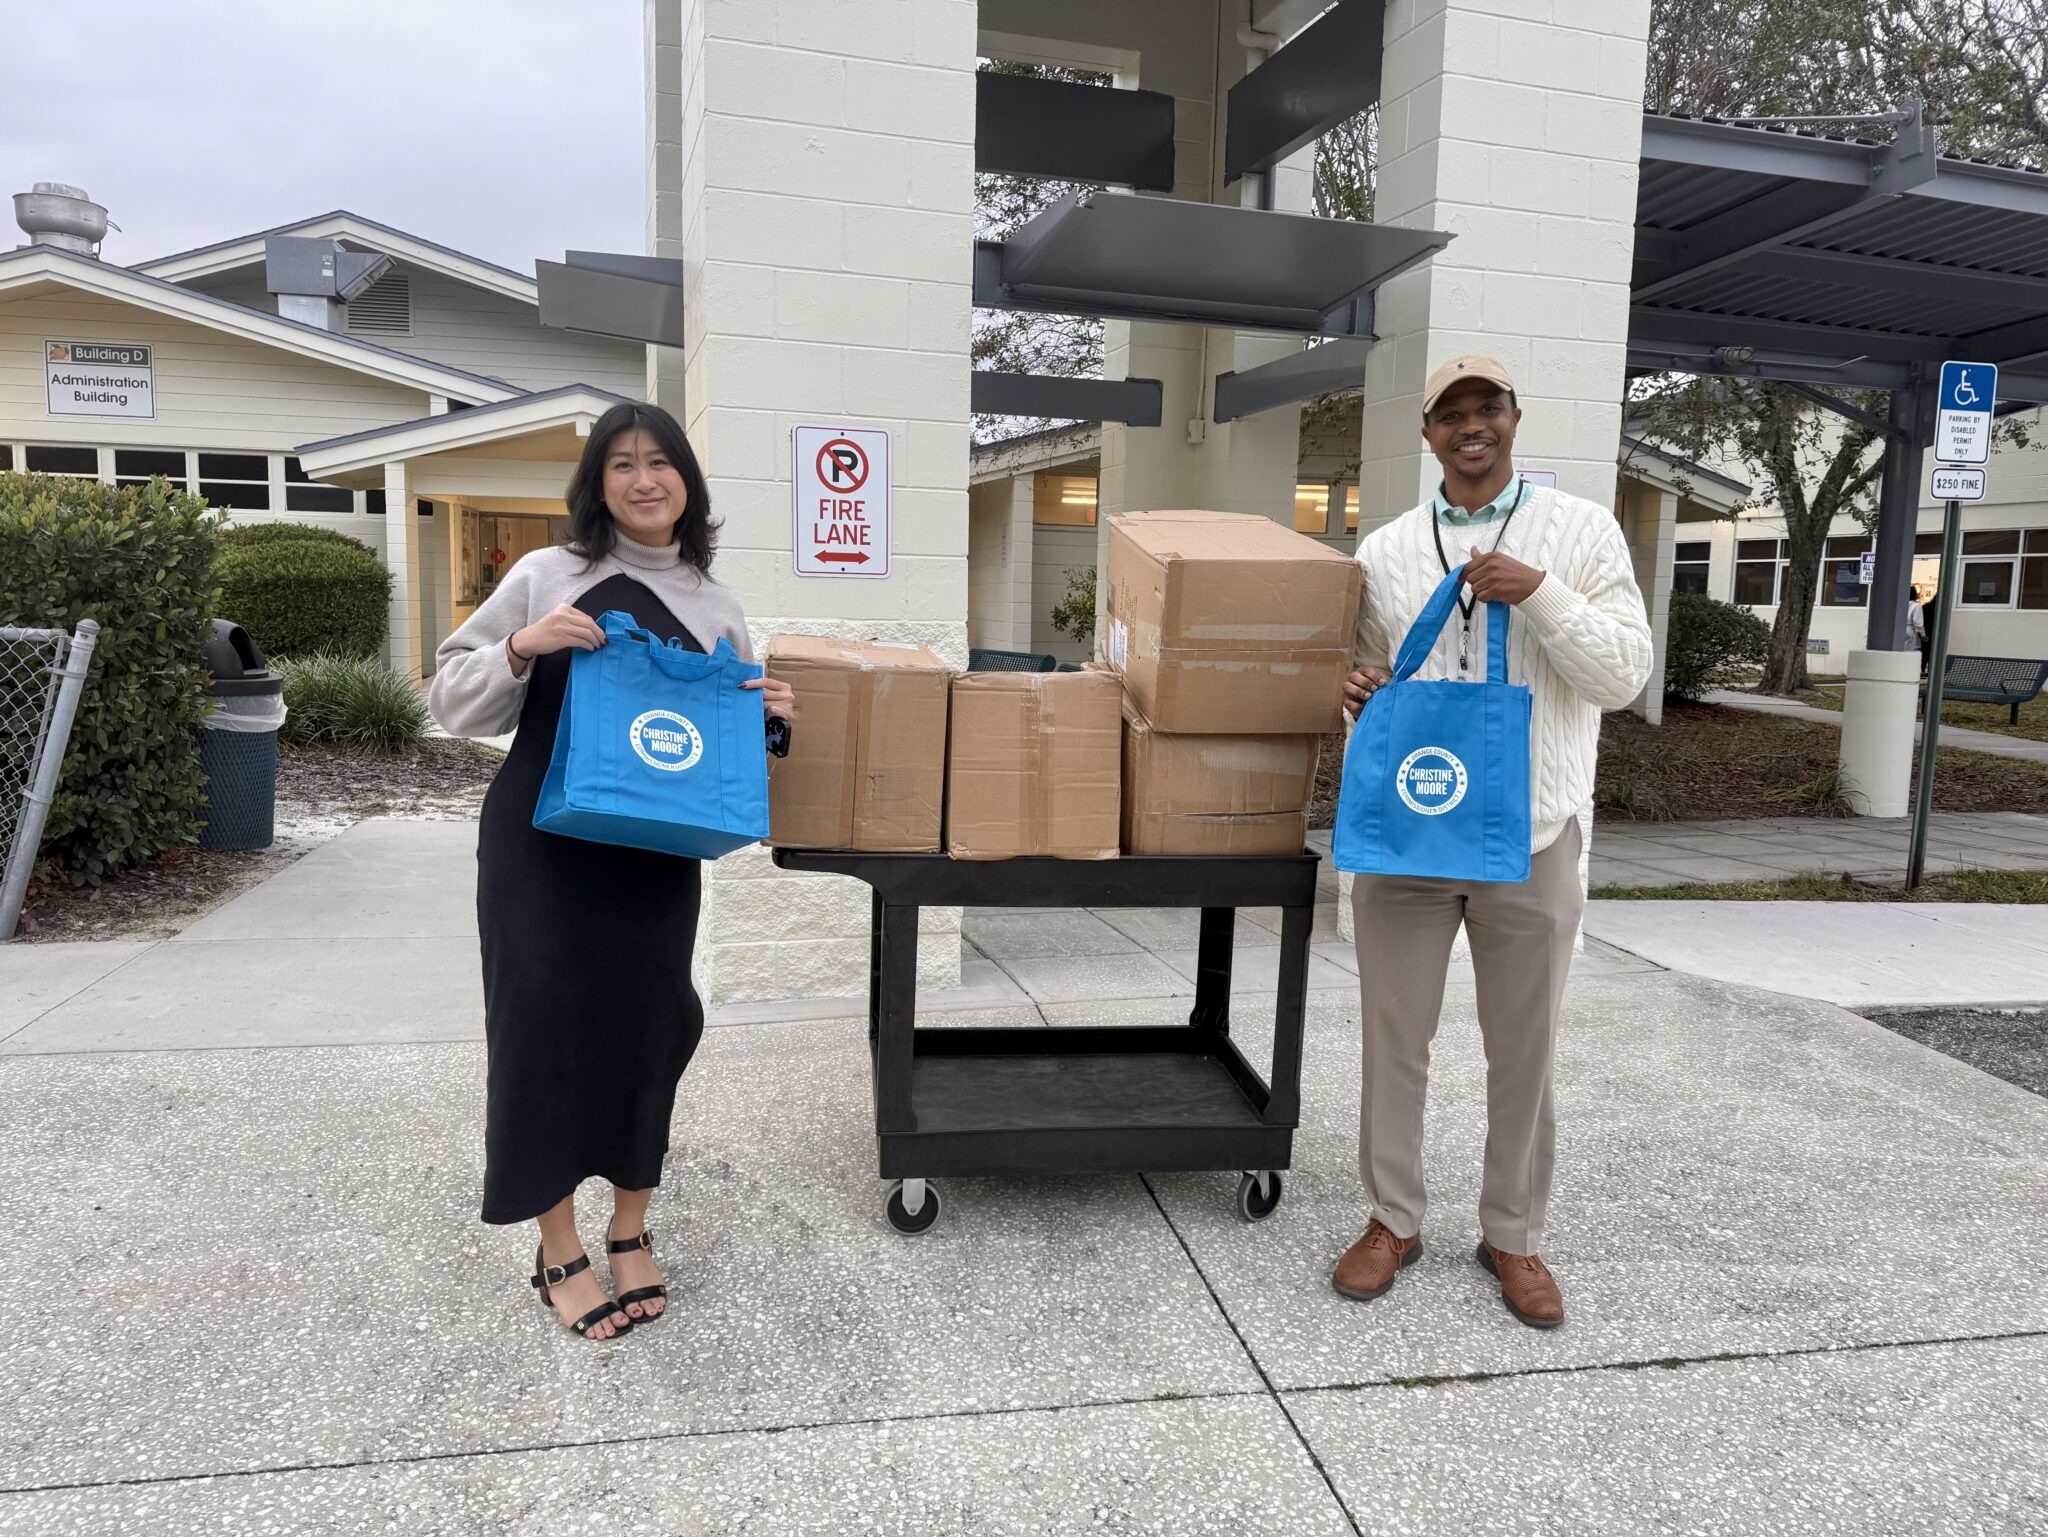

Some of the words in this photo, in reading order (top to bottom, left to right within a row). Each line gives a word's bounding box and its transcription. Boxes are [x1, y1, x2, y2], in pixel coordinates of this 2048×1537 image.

[75, 347, 130, 363] Building
[133, 350, 143, 361] D
[51, 373, 149, 389] Administration
[74, 390, 128, 406] Building
[1949, 415, 1971, 423] PARKING
[1951, 426, 1976, 434] DISABLED
[1953, 437, 1972, 445] PERMIT
[1936, 478, 1958, 489] $250
[1961, 479, 1979, 490] FINE
[820, 498, 865, 521] FIRE
[814, 522, 871, 545] LANE
[643, 727, 688, 744] CHRISTINE
[651, 740, 684, 755] MOORE
[1411, 749, 1433, 760] ORANGE
[1433, 748, 1455, 762] COUNTY
[1409, 768, 1453, 781] CHRISTINE
[1416, 782, 1448, 795] MOORE
[1400, 788, 1438, 813] COMMISSIONER
[1438, 795, 1460, 812] DISTRICT
